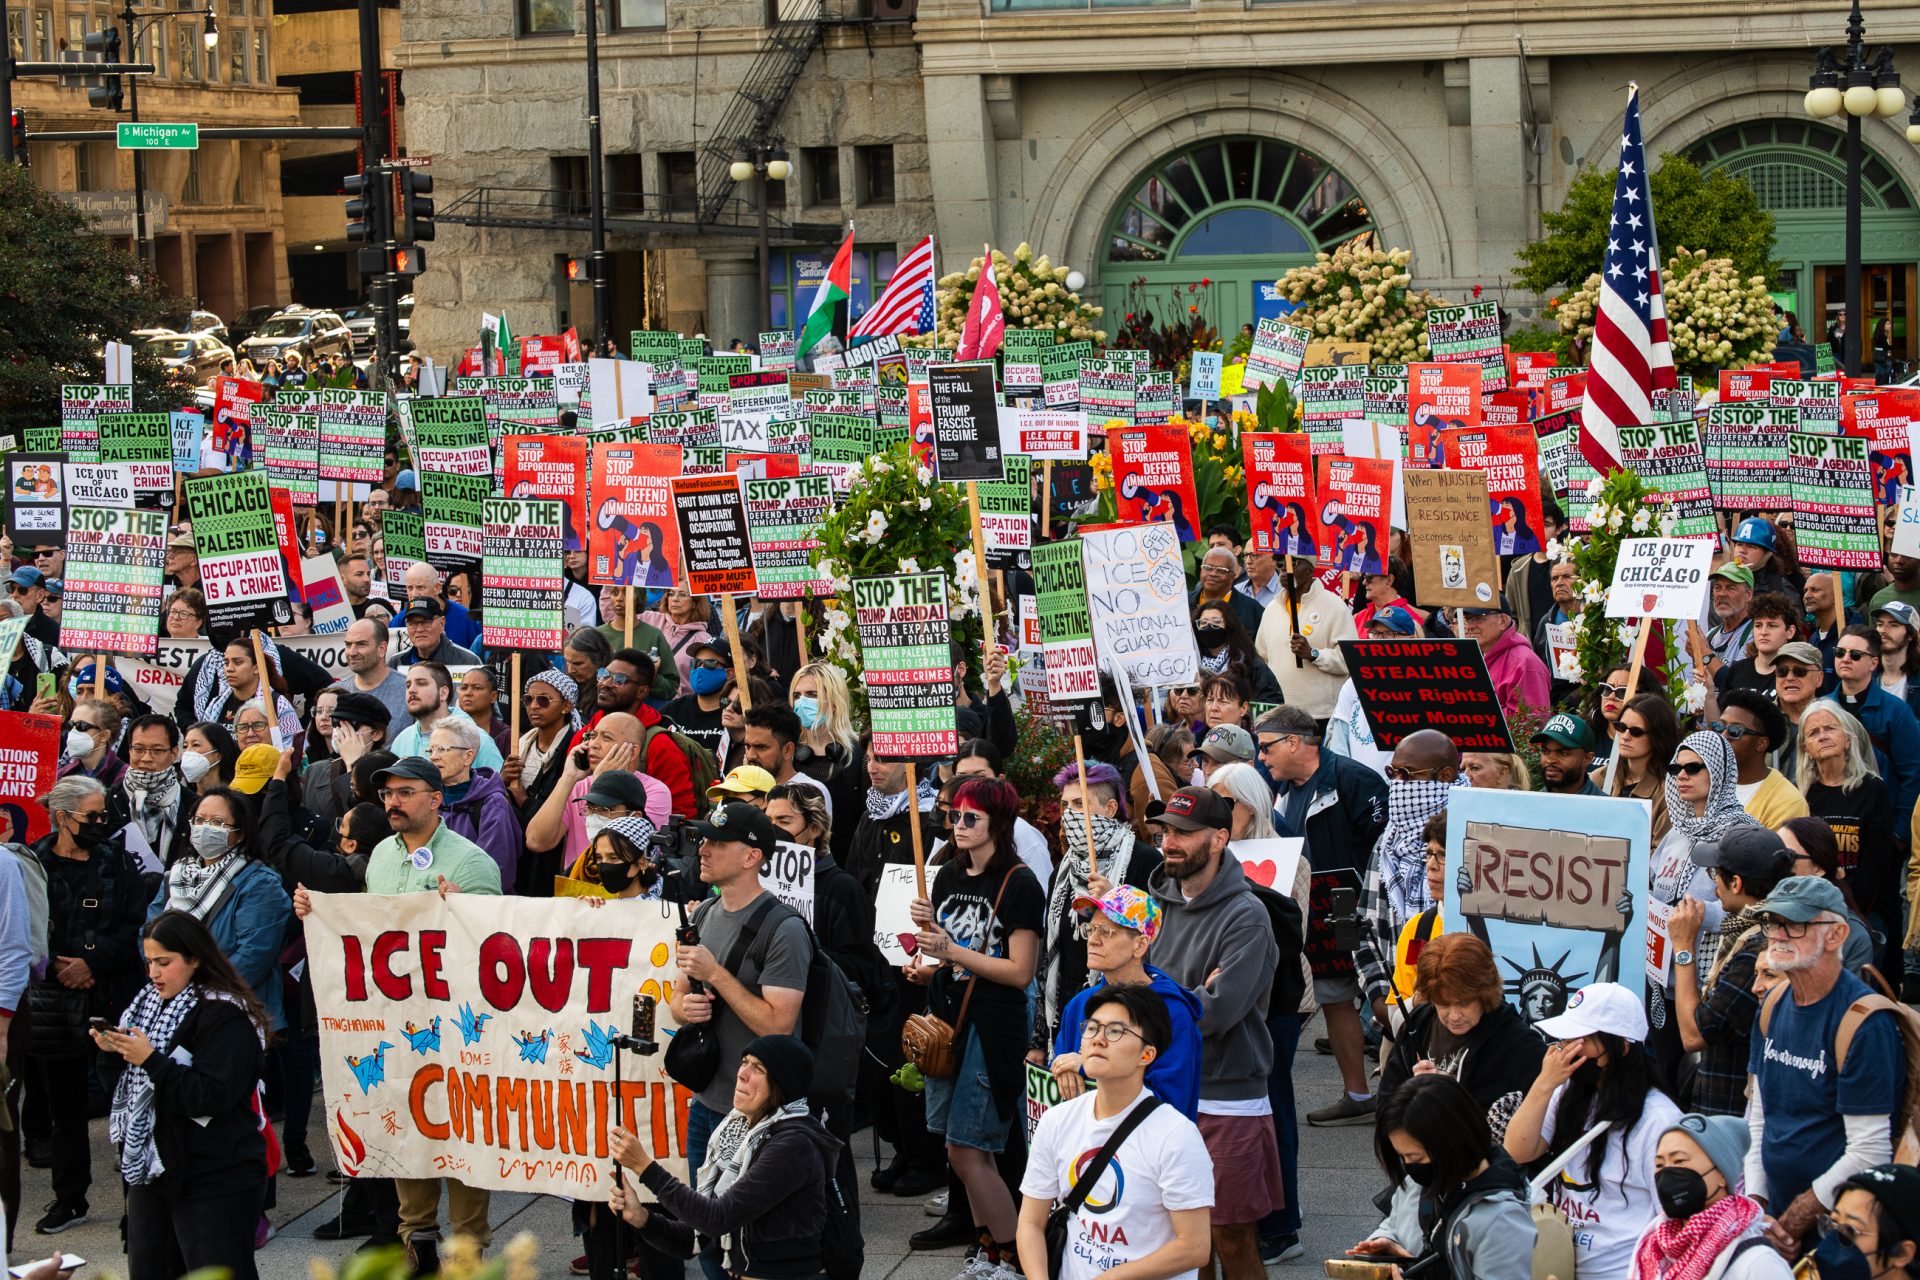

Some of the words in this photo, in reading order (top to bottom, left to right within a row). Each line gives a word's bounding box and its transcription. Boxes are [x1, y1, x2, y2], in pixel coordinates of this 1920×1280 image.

[133, 127, 177, 139] Michigan
[845, 337, 899, 368] ABOLISH
[1201, 357, 1214, 366] ICE
[730, 376, 758, 387] CPOP
[761, 373, 786, 383] NOW!
[1198, 381, 1213, 389] CHI
[1420, 376, 1442, 386] STOP
[731, 389, 773, 398] SUPPORT
[775, 386, 787, 394] THE
[934, 383, 951, 393] THE
[952, 383, 973, 393] FALL
[732, 395, 788, 407] REFERENDUM
[941, 395, 950, 403] the
[1437, 396, 1470, 405] DEFEND
[936, 405, 970, 417] TRUMP
[1420, 406, 1470, 415] IMMIGRANTS
[176, 419, 194, 430] ICE
[938, 417, 976, 429] FASCIST
[174, 430, 194, 439] OUT
[722, 419, 762, 442] TAX
[939, 429, 978, 441] REGIME
[1026, 432, 1044, 440] I.C.E.
[1046, 432, 1060, 440] OUT
[1063, 432, 1073, 440] OF
[1026, 441, 1073, 450] EVERYWHERE
[1790, 436, 1828, 456] STOP
[1832, 438, 1866, 459] THE
[173, 448, 191, 458] CHI
[606, 460, 633, 474] STOP
[1791, 458, 1820, 468] TRUMP
[1823, 459, 1867, 471] AGENDA!
[76, 468, 94, 479] ICE
[97, 469, 118, 479] OUT
[1408, 474, 1432, 487] When
[1438, 472, 1486, 487] INJUSTICE
[606, 475, 668, 486] DEPORTATIONS
[676, 480, 734, 489] RefuseFascism.org
[72, 486, 128, 498] CHICAGO
[188, 481, 214, 494] FROM
[626, 488, 667, 503] DEFEND
[677, 496, 696, 508] SHUT
[699, 495, 720, 506] DOWN
[722, 493, 739, 504] ICE!
[1407, 492, 1441, 503] becomes
[1467, 491, 1481, 502] then
[190, 487, 268, 518] CHICAGO
[605, 503, 667, 516] IMMIGRANTS
[688, 511, 698, 521] NO
[699, 509, 732, 520] MILITARY
[1419, 510, 1479, 521] RESISTANCE
[260, 514, 271, 524] TO
[690, 521, 736, 533] OCCUPATION!
[197, 527, 275, 554] PALESTINE
[690, 539, 705, 548] Shut
[708, 538, 726, 547] Down
[727, 537, 741, 546] The
[1143, 526, 1158, 549] GET
[1413, 528, 1453, 542] becomes
[1459, 530, 1478, 546] duty
[1085, 531, 1137, 563] NO
[1149, 530, 1172, 560] OUT!
[1632, 544, 1657, 556] ICE
[1661, 544, 1694, 558] OUT
[694, 550, 717, 559] Whole
[718, 549, 740, 560] Trump
[203, 556, 279, 579] OCCUPATION
[691, 561, 717, 570] Fascist
[718, 557, 747, 570] Regime!
[1651, 557, 1666, 566] OF
[693, 574, 723, 583] TRUMP
[726, 572, 752, 580] MUST
[1103, 562, 1149, 584] ICE
[1151, 558, 1174, 586] STAY
[1621, 567, 1700, 583] CHICAGO
[206, 582, 219, 599] IS
[226, 581, 235, 597] A
[240, 575, 282, 595] CRIME!
[1161, 566, 1183, 595] OUT!
[704, 584, 718, 592] GO
[720, 583, 744, 591] NOW!
[856, 580, 894, 607] STOP
[900, 577, 942, 604] THE
[1092, 589, 1140, 618] NO
[858, 609, 885, 623] TRUMP
[890, 605, 944, 622] AGENDA!
[313, 616, 349, 634] TRUMP
[860, 626, 886, 636] DEFEND
[892, 625, 897, 634] &
[903, 622, 948, 634] EXPAND
[1106, 615, 1185, 638] NATIONAL
[860, 636, 902, 646] IMMIGRANT
[908, 633, 949, 644] RIGHTS
[1114, 633, 1169, 654] GUARD
[1353, 643, 1457, 656] TRUMP'S
[866, 673, 879, 682] STOP
[882, 672, 909, 681] POLICE
[913, 670, 951, 680] CRIMES
[1127, 656, 1191, 683] HICAGO!
[1360, 666, 1476, 679] STEALING
[136, 669, 184, 686] ISRAE
[868, 686, 887, 696] DEFEND
[890, 686, 927, 696] LGBTQIA+
[931, 684, 953, 694] AND
[1363, 689, 1413, 701] Your
[1418, 688, 1489, 704] Rights
[869, 698, 915, 707] REPRODUCTIVE
[918, 696, 953, 706] RIGHTS
[1372, 711, 1421, 724] Your
[1425, 711, 1497, 727] Money
[1457, 733, 1506, 746] ealth
[888, 869, 913, 883] THE
[1474, 844, 1623, 905] RESIST
[778, 882, 791, 892] THE
[341, 930, 450, 1001] ICE
[479, 932, 632, 1013] OUT
[322, 1017, 385, 1031] TANGHANAN
[380, 1108, 402, 1136] 家
